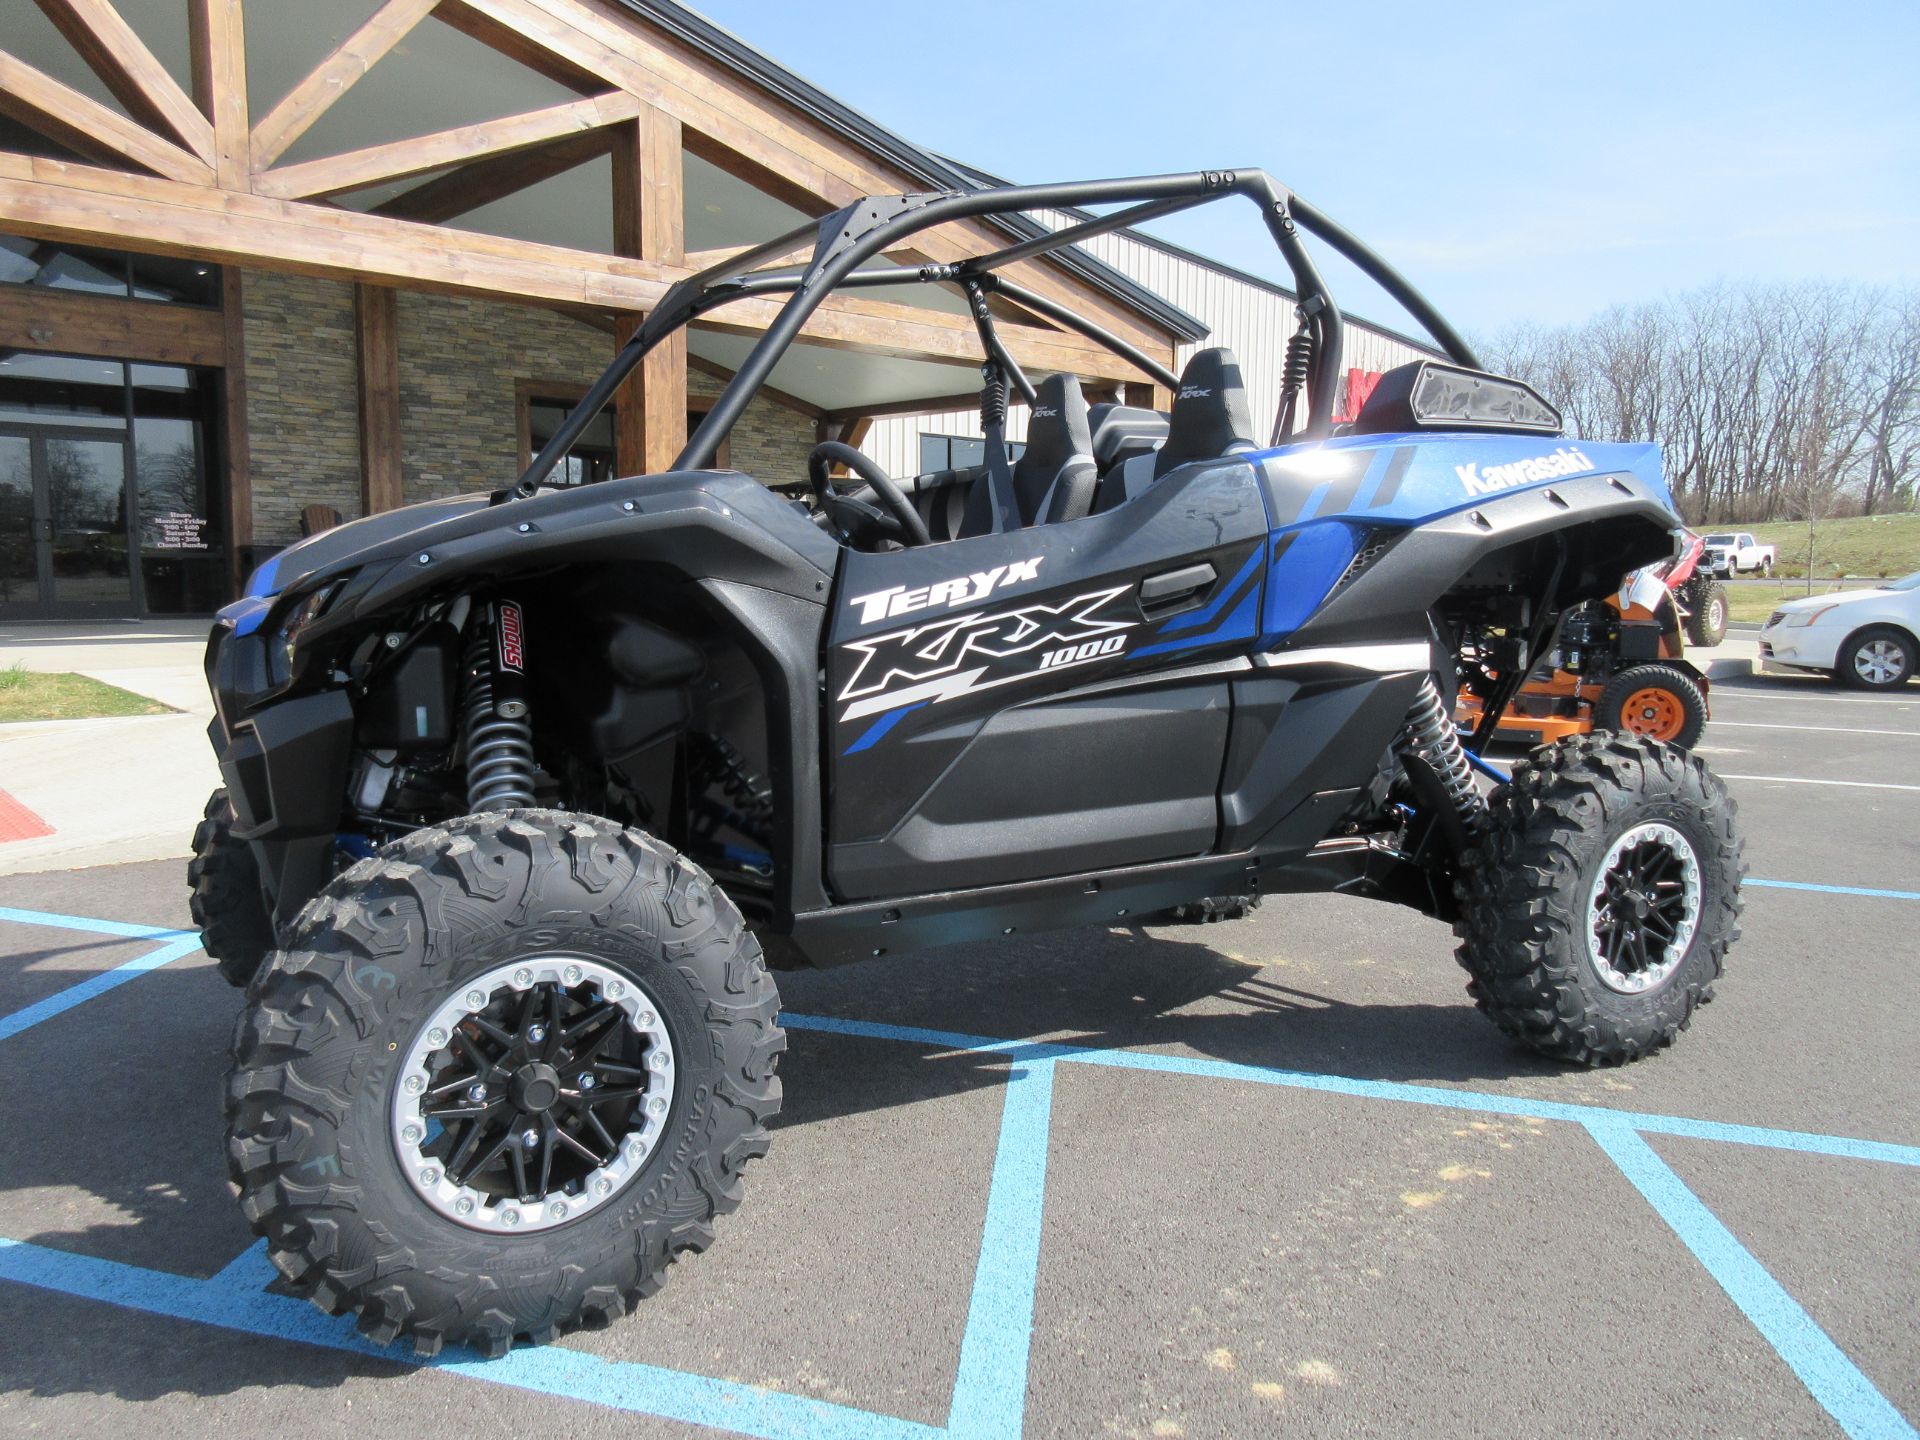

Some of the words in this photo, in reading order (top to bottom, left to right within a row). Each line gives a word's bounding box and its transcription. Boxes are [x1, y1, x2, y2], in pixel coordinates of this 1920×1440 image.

[1455, 446, 1595, 497] Kawasaki
[850, 556, 1044, 625] TERYX
[501, 606, 523, 670] SHOWA
[1039, 634, 1128, 671] 1000
